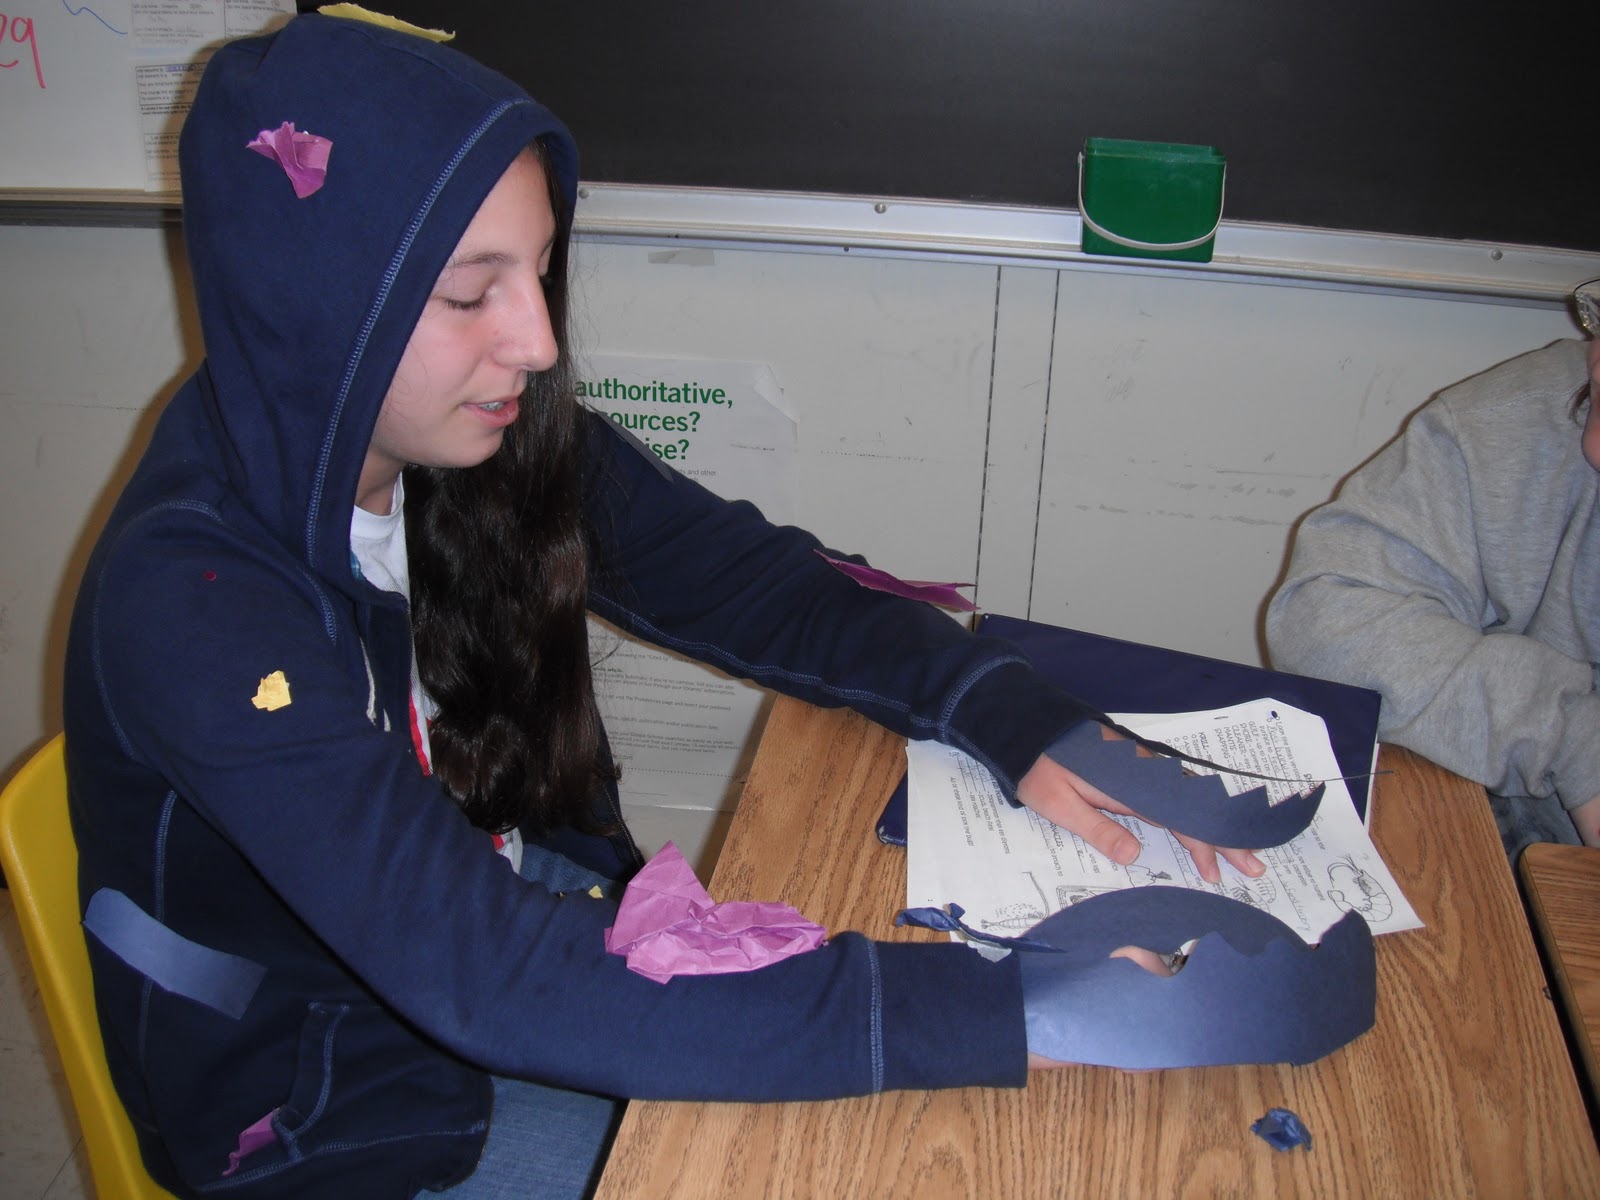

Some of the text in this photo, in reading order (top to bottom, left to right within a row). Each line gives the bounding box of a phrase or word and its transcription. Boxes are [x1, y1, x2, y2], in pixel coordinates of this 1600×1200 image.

[576, 378, 733, 408] authoritative,
[1224, 727, 1237, 750] MANTIS
[1240, 723, 1252, 743] SHORE
[1248, 721, 1259, 736] GULF
[1276, 722, 1285, 735] Look
[1199, 732, 1209, 750] KRILL
[1214, 728, 1230, 758] SNAPPING
